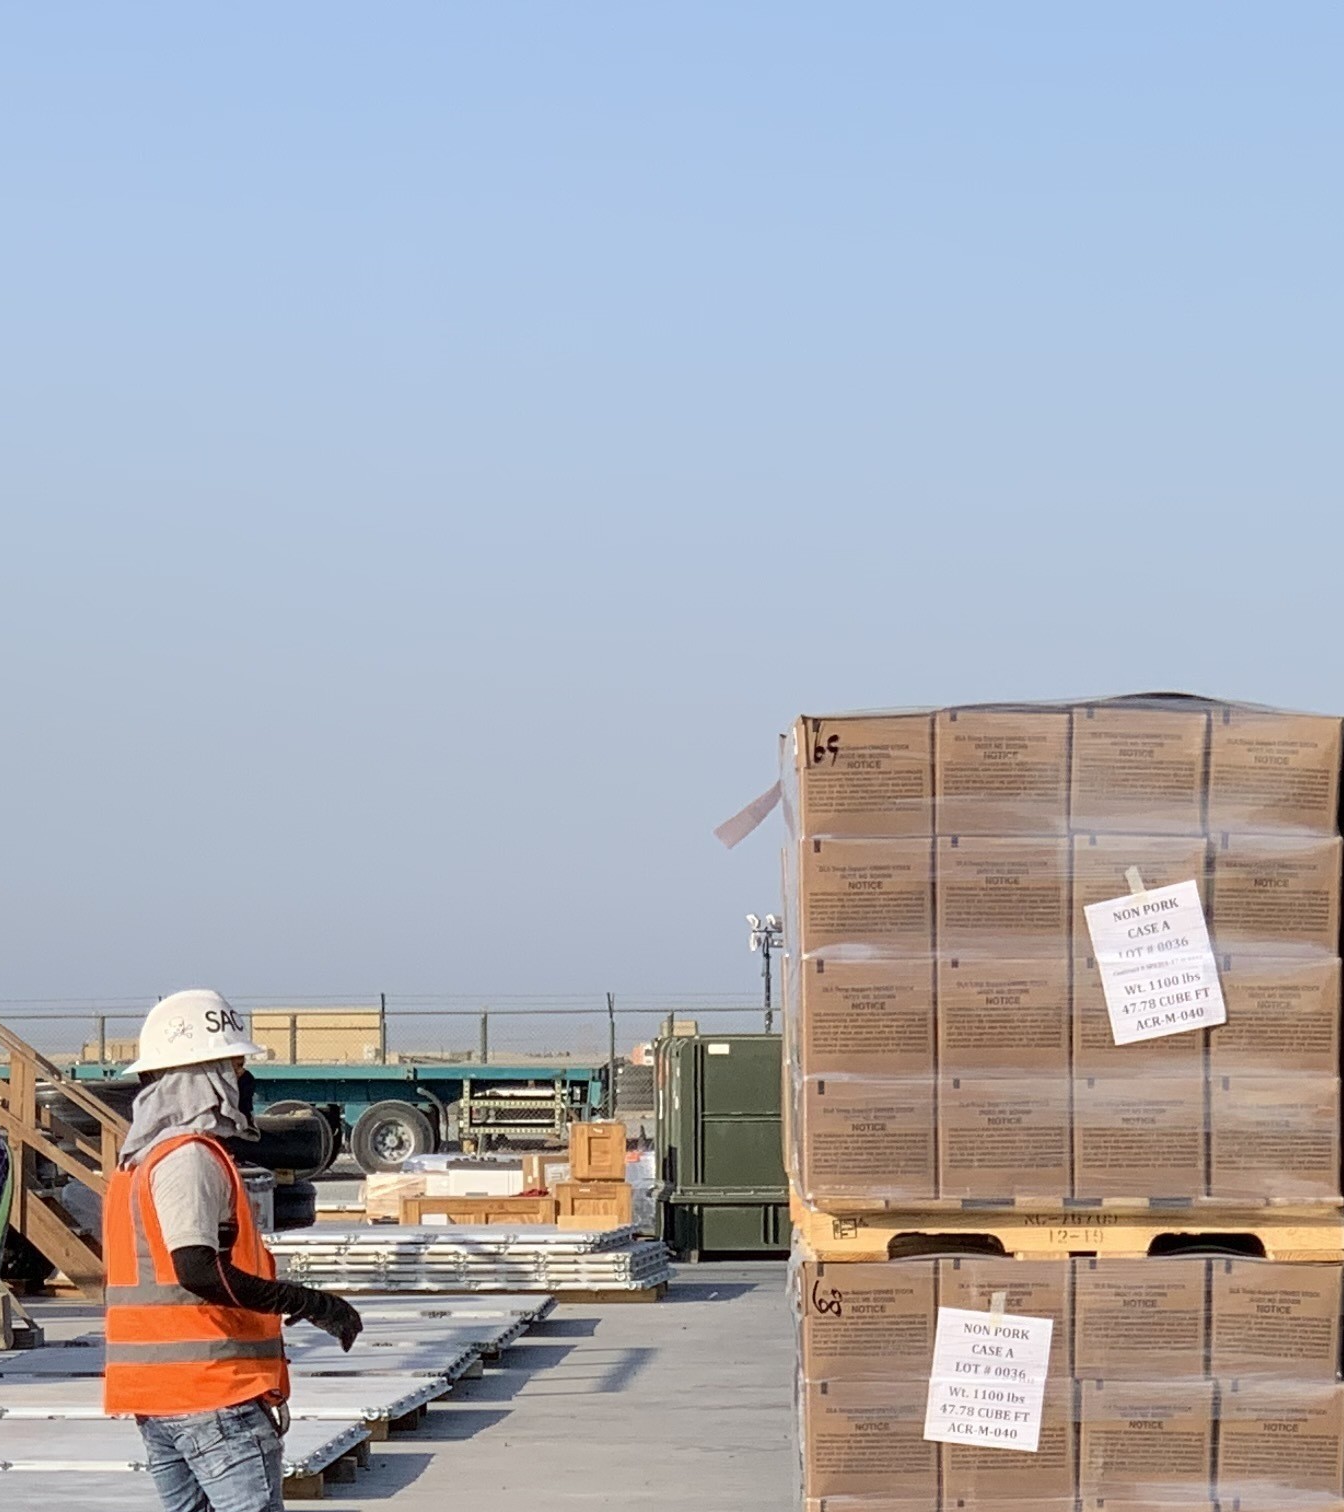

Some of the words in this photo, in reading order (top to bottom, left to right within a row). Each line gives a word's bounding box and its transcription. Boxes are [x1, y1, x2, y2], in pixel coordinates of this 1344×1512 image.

[847, 760, 881, 769] NOTICE
[1254, 756, 1290, 766] NOTICE
[848, 881, 883, 890] NOTICE
[985, 876, 1020, 885] NOTICE
[1254, 878, 1290, 888] NOTICE
[1113, 902, 1141, 922] NON
[1143, 898, 1179, 915] PORK
[1127, 922, 1159, 939] CASE
[1161, 920, 1171, 932] A
[1155, 937, 1189, 954] 0036
[1149, 976, 1180, 992] 1100
[1182, 970, 1201, 985] lbs
[985, 996, 1021, 1005] NOTICE
[1122, 998, 1157, 1016] 47.78
[1159, 991, 1191, 1007] CUBE
[1195, 987, 1210, 999] FT
[851, 1001, 886, 1011] NOTICE
[1135, 1007, 1205, 1032] ACR-M-040
[987, 1117, 1023, 1125] NOTICE
[851, 1123, 887, 1132] NOTICE
[1123, 1299, 1157, 1308] NOTICE
[851, 1304, 886, 1314] NOTICE
[1256, 1305, 1292, 1314] NOTICE
[964, 1323, 991, 1337] NON
[994, 1327, 1030, 1340] PORK
[972, 1344, 1003, 1358] CASE
[1005, 1348, 1014, 1359] A
[955, 1361, 981, 1375] LOT
[983, 1364, 991, 1375] #
[994, 1366, 1026, 1380] 0036
[973, 1389, 1004, 1403] 1100
[1006, 1393, 1025, 1405] lbs
[939, 1403, 975, 1417] 47.78
[977, 1407, 1012, 1421] CUBE
[1014, 1411, 1030, 1423] FT
[855, 1423, 890, 1431] NOTICE
[1129, 1421, 1164, 1429] NOTICE
[1263, 1423, 1298, 1433] NOTICE
[947, 1422, 1018, 1440] ACR-M-040
